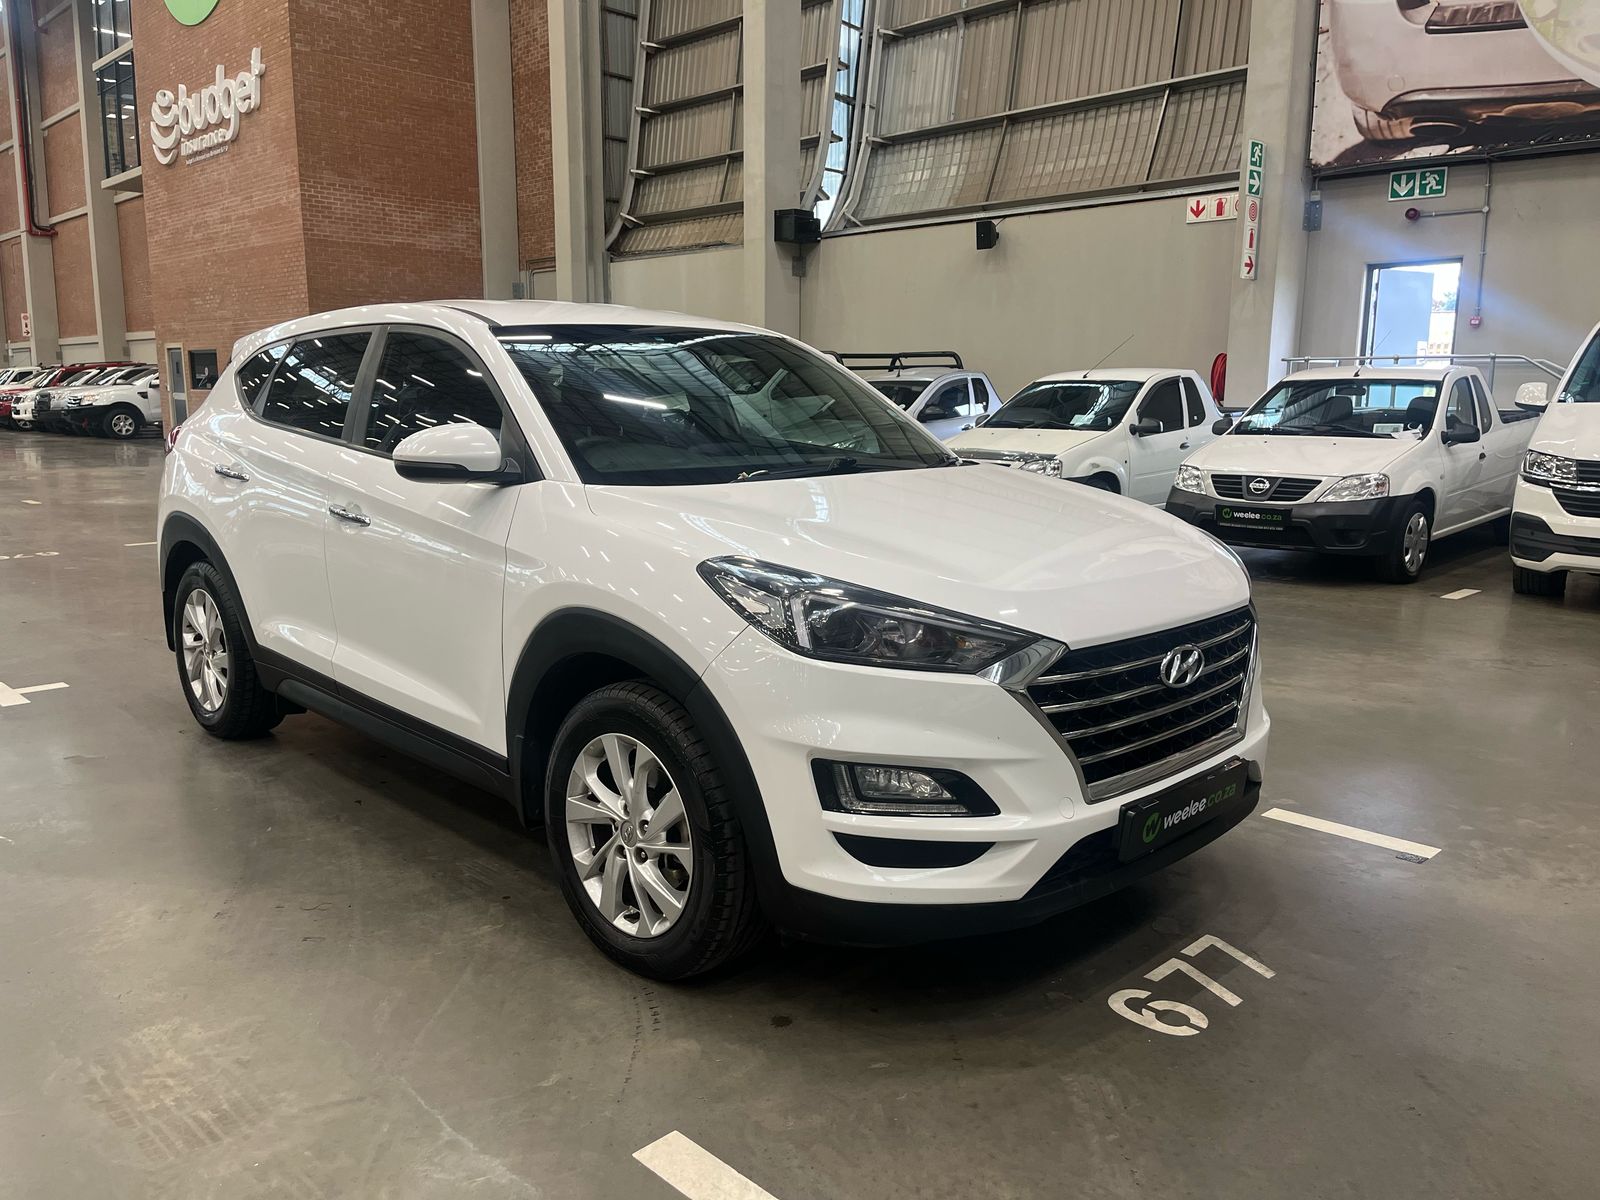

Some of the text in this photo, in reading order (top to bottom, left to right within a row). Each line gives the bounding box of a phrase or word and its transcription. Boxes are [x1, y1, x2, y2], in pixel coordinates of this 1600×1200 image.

[178, 46, 266, 142] budget
[180, 128, 228, 156] insurance
[1107, 934, 1277, 1037] 677
